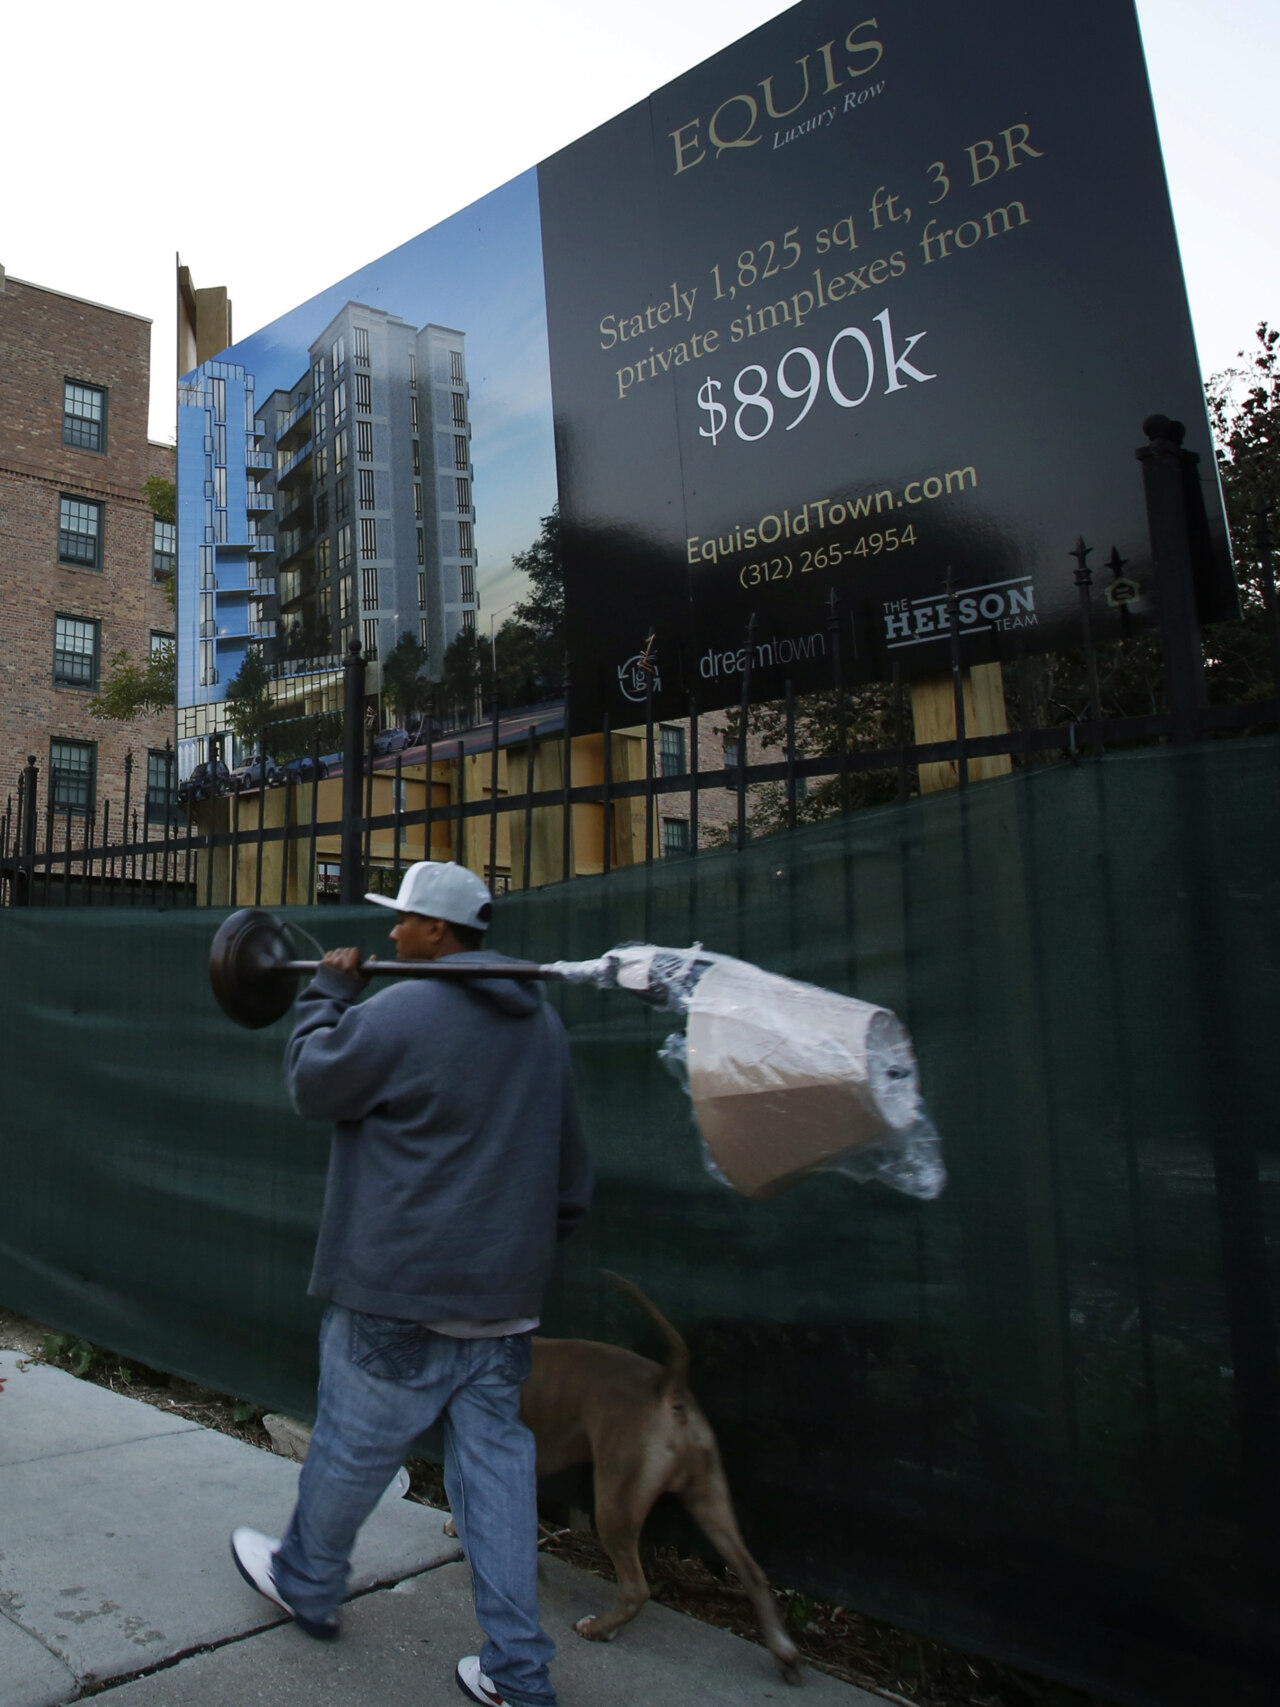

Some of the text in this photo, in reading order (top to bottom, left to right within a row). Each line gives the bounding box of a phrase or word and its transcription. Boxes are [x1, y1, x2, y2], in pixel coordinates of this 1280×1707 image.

[668, 18, 885, 176] EQUIS
[772, 80, 887, 150] Luxury Row
[599, 122, 1044, 351] Stately 1,825 sq ft, 3 BR
[616, 199, 1031, 398] private simplexes from
[696, 307, 937, 446] $890k
[686, 464, 978, 565] EquisOldTown.com
[739, 524, 918, 590] (312) 265-4954
[883, 598, 908, 614] THE
[994, 613, 1039, 632] TEAM
[700, 632, 826, 679] dreamtown
